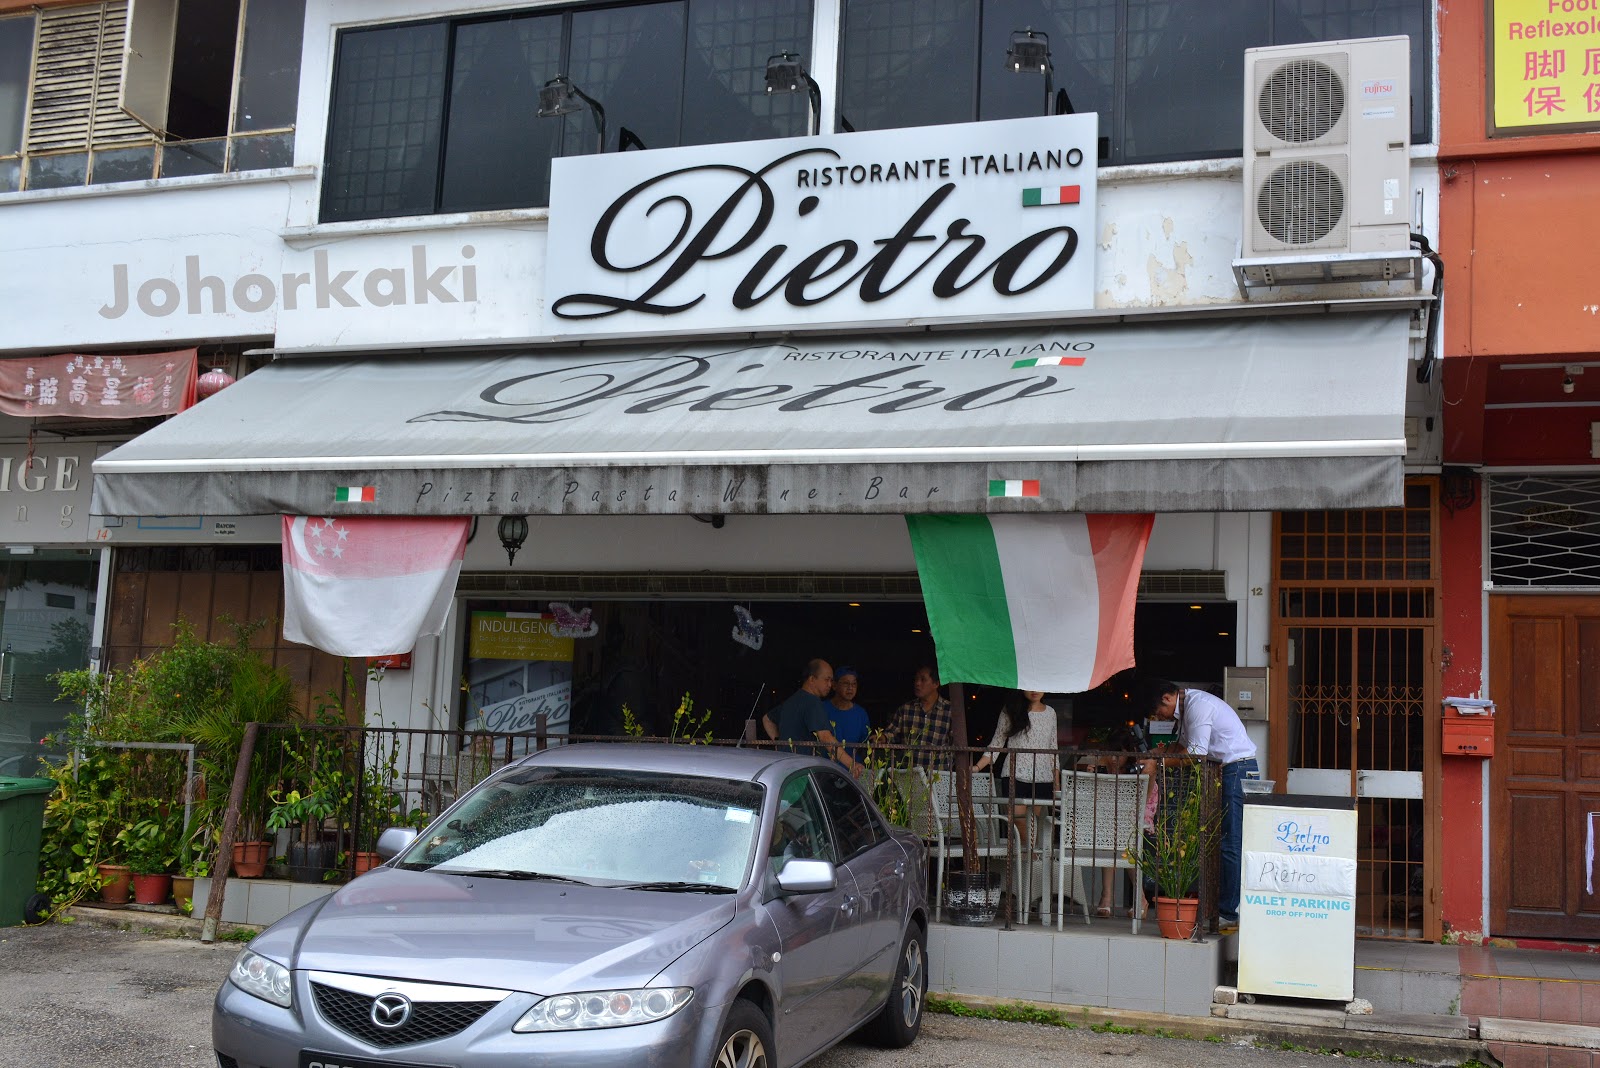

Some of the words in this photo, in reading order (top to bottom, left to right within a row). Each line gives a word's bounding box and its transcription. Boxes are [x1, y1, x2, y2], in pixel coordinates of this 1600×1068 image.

[1364, 82, 1393, 95] FUJITSU
[797, 157, 950, 188] RISTORANTE
[961, 147, 1085, 176] ITALIANO
[551, 147, 1079, 320] Pietro
[782, 349, 955, 363] RISTORANTE
[961, 341, 1095, 360] ITALIANO
[406, 344, 1075, 424] Pietro
[416, 482, 519, 504] Pizza
[562, 481, 678, 503] Pasta
[864, 476, 940, 500] Bar
[96, 529, 108, 541] 14
[1251, 587, 1263, 596] 12
[479, 620, 557, 635] INDULGENC
[1259, 861, 1316, 883] Pietro
[1245, 895, 1287, 907] VALET
[1291, 898, 1351, 911] PARKING
[1266, 909, 1287, 917] DROP
[1288, 910, 1303, 918] OFF
[1305, 912, 1329, 920] POINT
